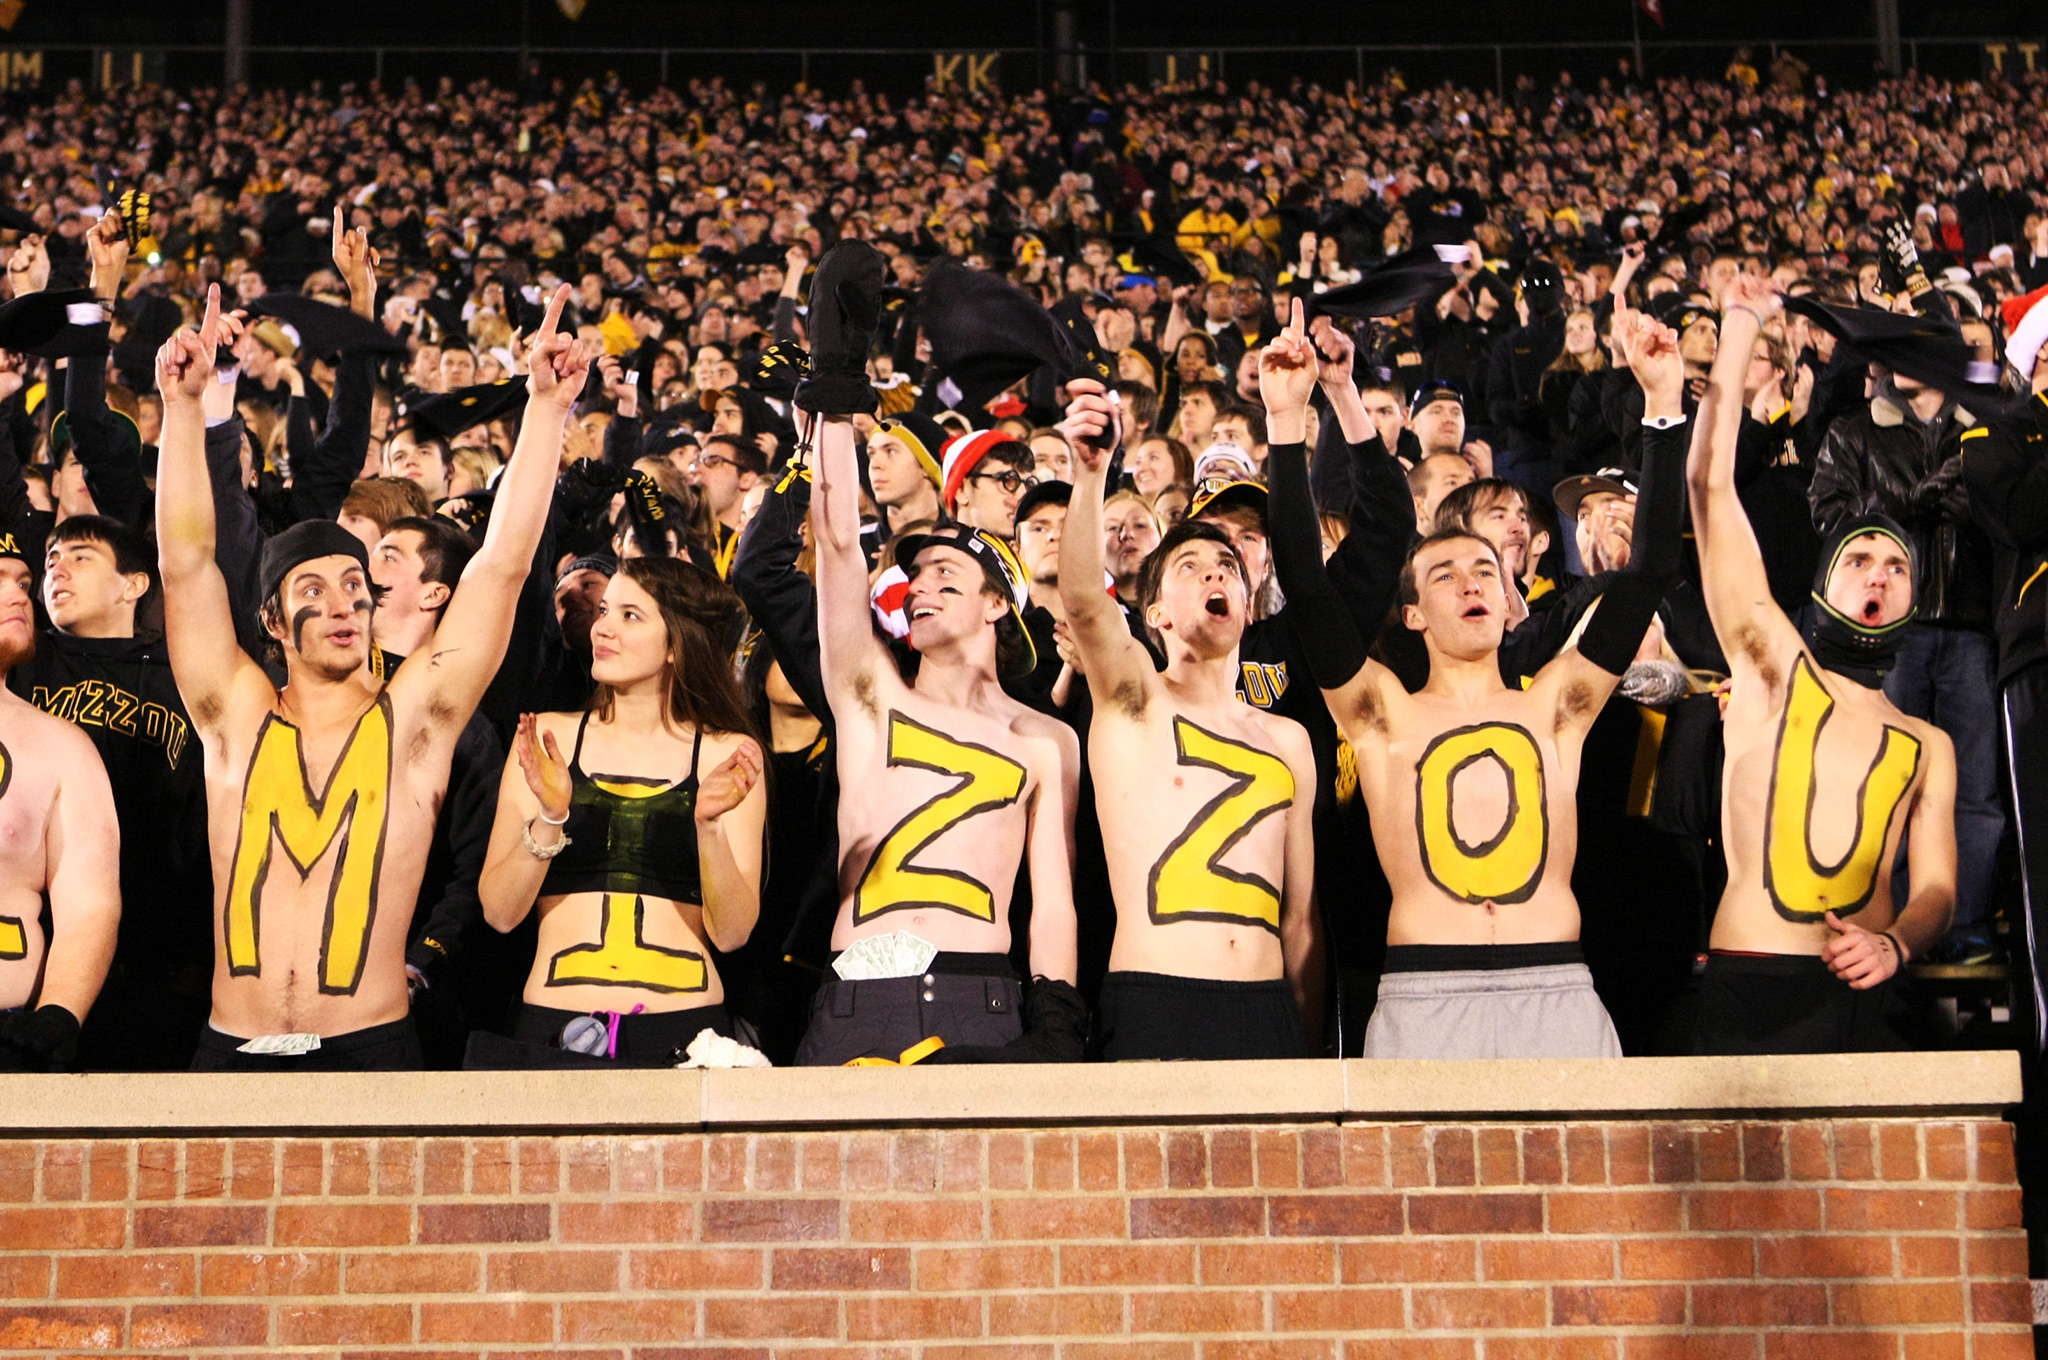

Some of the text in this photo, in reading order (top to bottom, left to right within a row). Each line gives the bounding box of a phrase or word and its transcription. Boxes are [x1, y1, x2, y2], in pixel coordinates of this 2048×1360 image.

[935, 53, 996, 93] KK
[1985, 43, 2040, 76] TT
[1236, 660, 1290, 708] OU
[31, 679, 189, 770] MIZZOU
